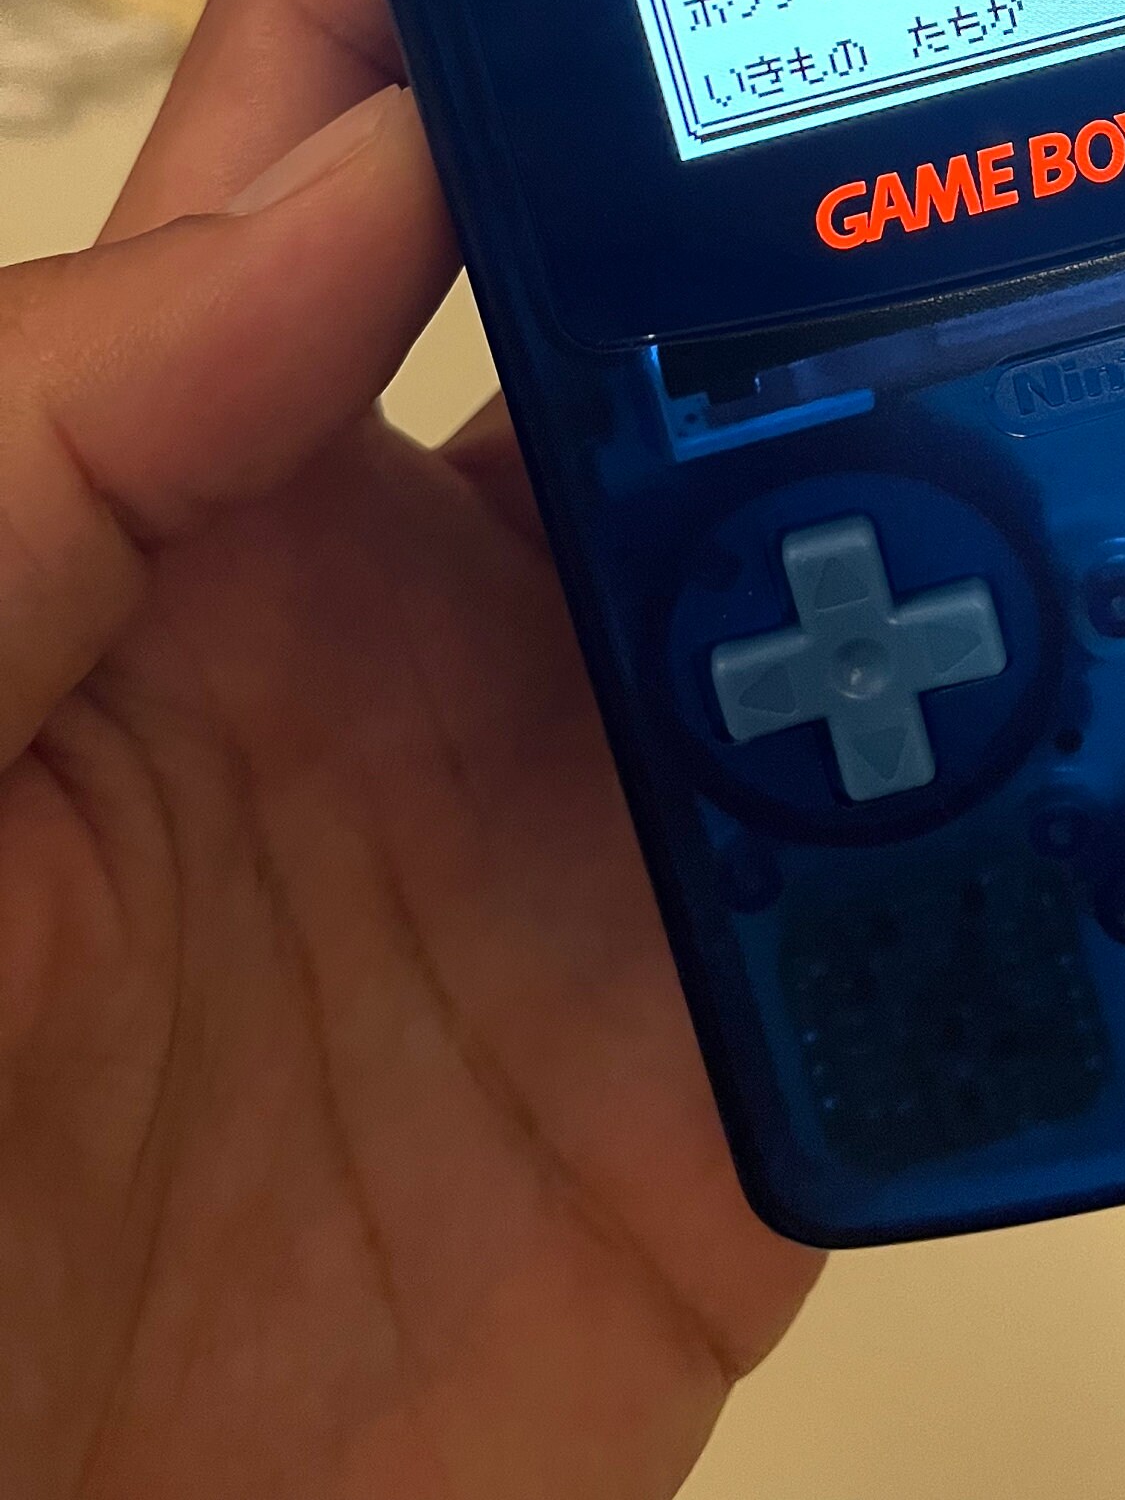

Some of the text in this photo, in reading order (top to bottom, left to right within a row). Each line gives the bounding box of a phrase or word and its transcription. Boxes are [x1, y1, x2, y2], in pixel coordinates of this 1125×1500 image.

[704, 38, 868, 108] いきもの
[815, 141, 1019, 250] GAME
